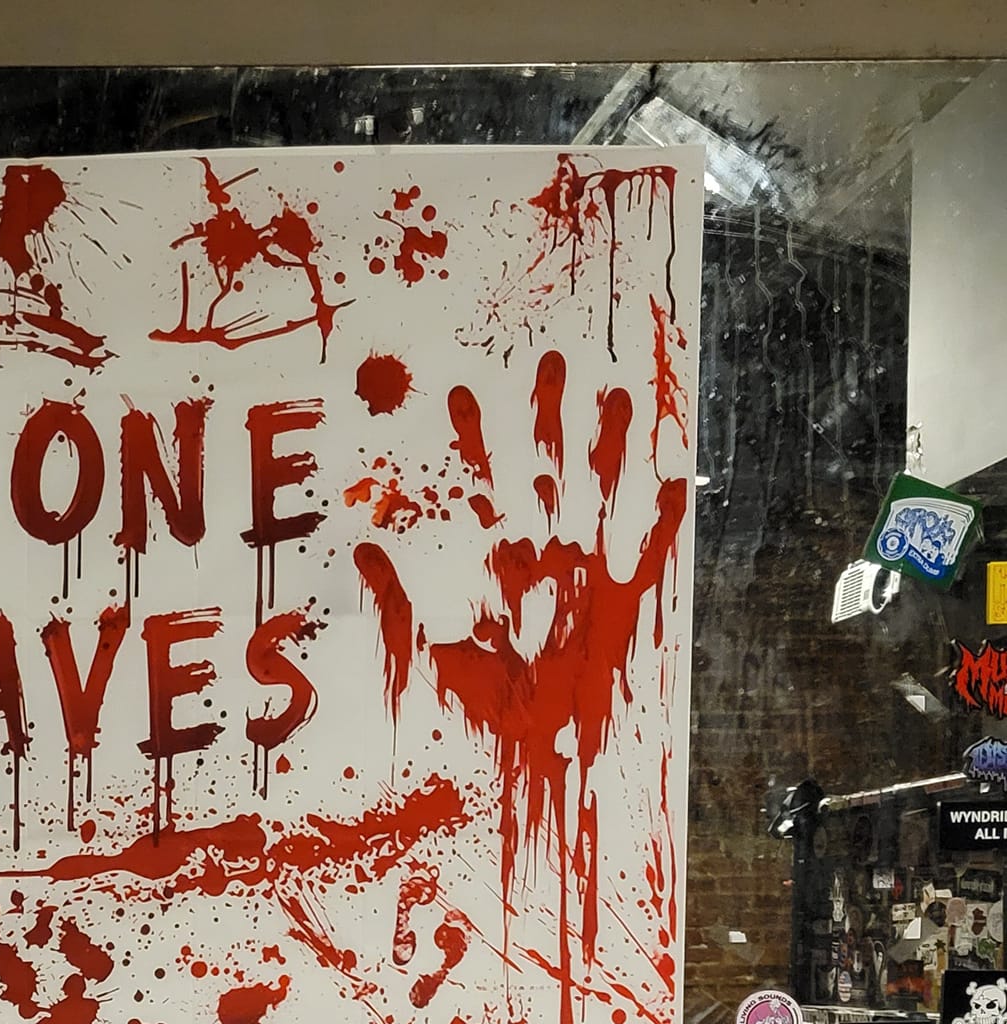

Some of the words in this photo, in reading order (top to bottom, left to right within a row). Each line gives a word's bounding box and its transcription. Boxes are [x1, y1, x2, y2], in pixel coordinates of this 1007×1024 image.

[10, 398, 328, 556] ONE
[974, 827, 1000, 840] ALL
[740, 1000, 757, 1024] LIVING
[758, 993, 792, 1007] SOUNDS
